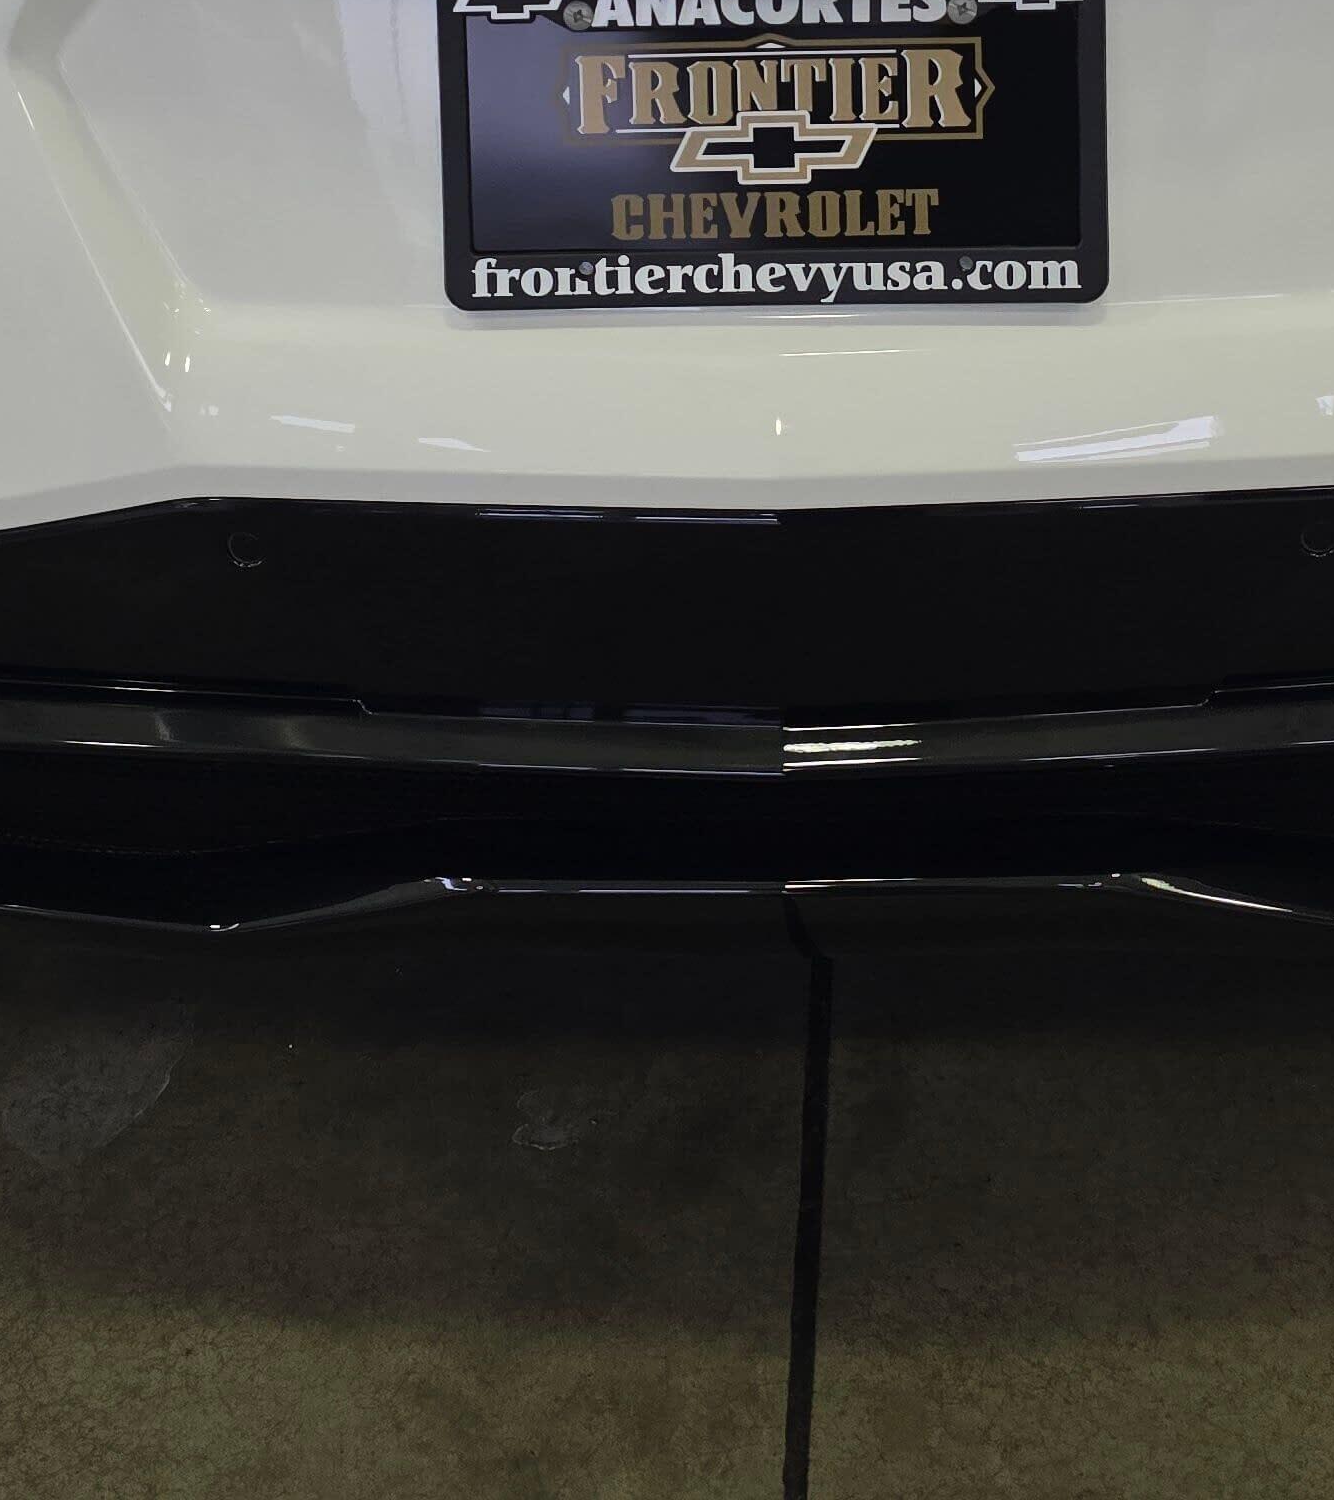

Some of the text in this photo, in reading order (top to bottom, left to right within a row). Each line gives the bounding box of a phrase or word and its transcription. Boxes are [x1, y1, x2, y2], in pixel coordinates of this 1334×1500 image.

[574, 48, 972, 136] FRONTIER
[609, 188, 939, 242] CHEVROLET
[471, 252, 1083, 304] frontierchevyusa.com
